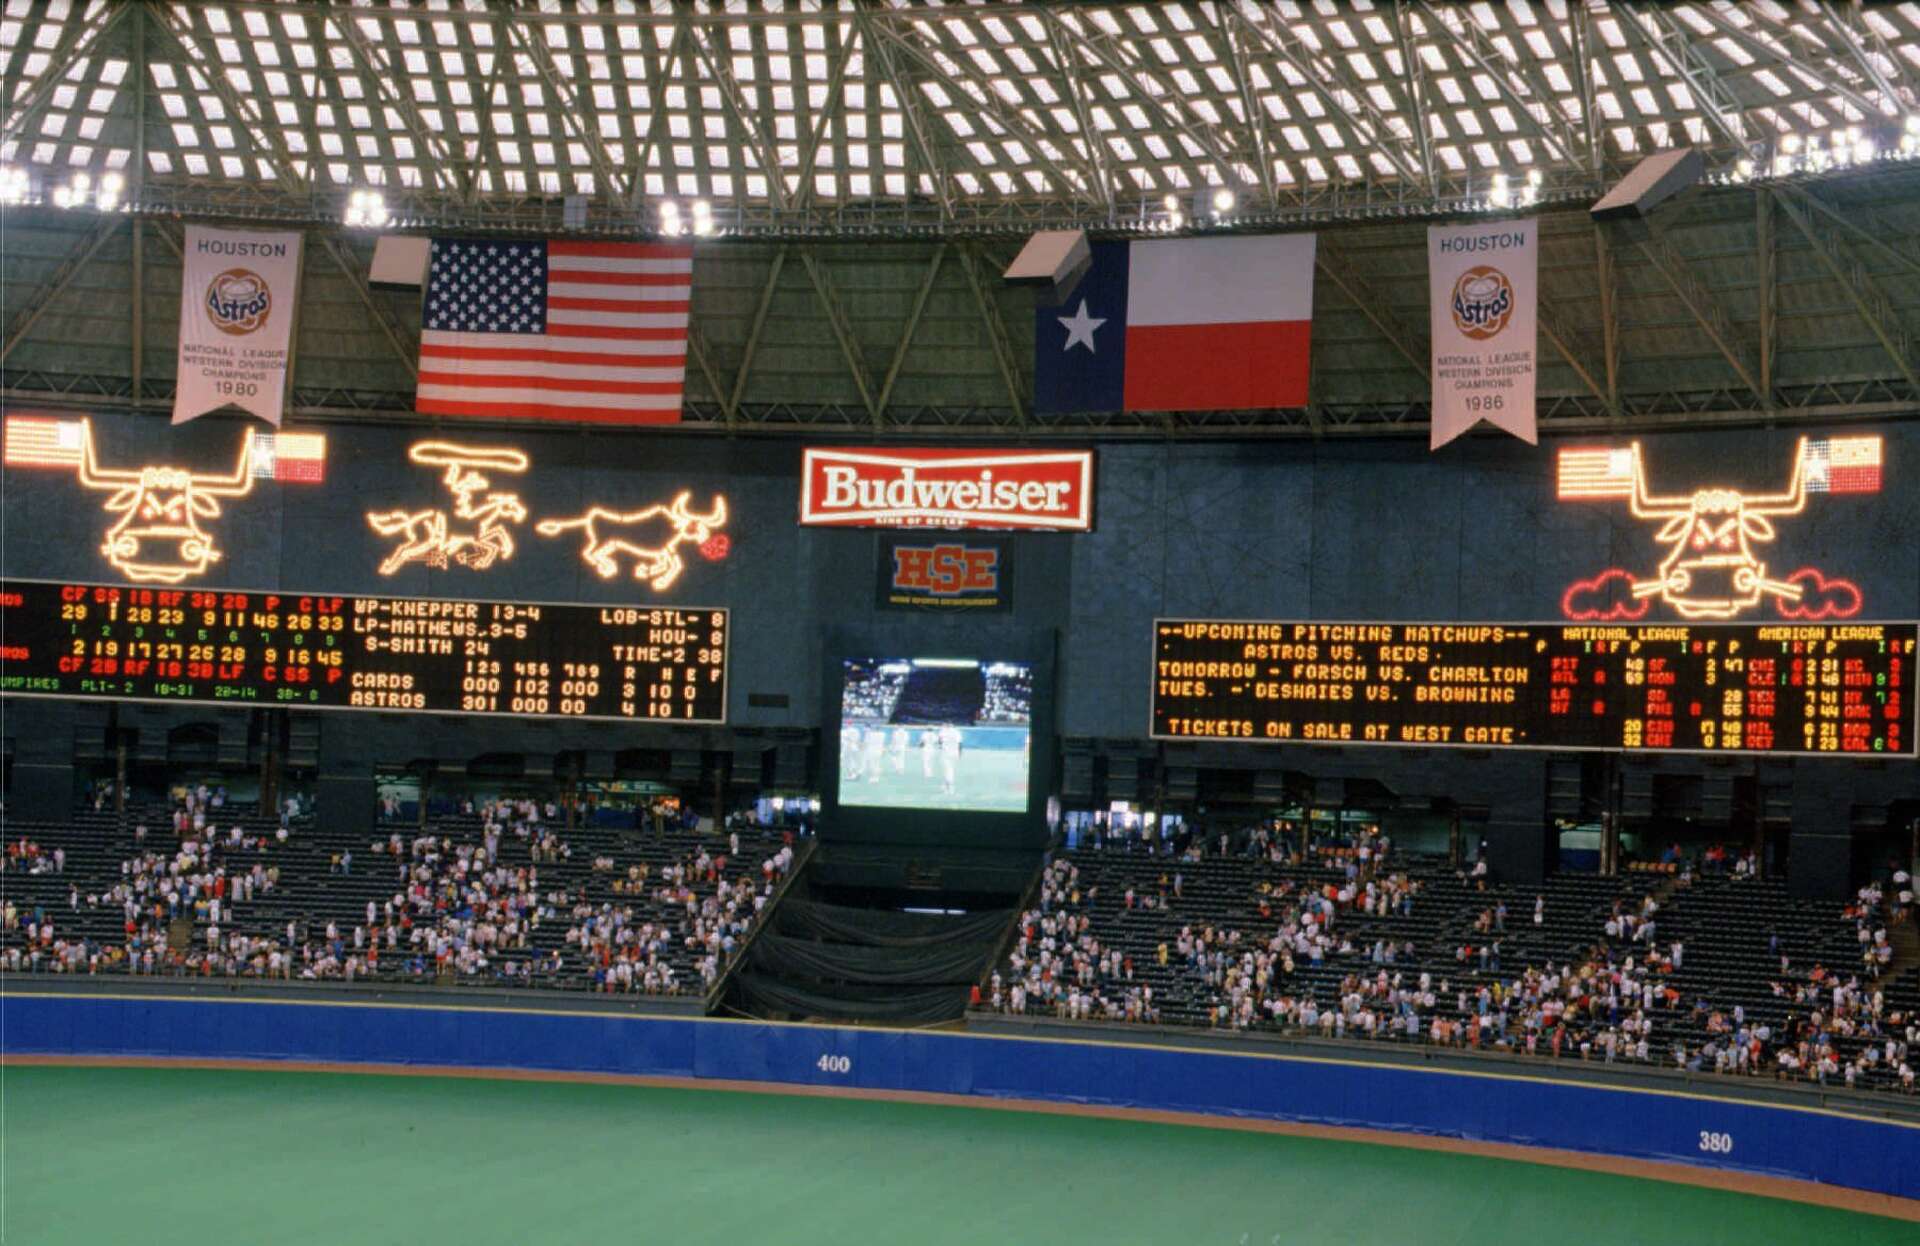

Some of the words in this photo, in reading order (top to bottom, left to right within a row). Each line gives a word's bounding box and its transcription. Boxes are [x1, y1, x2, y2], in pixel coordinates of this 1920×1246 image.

[198, 240, 286, 257] HOUSTON
[1440, 232, 1524, 252] HOUSTON
[209, 289, 267, 320] Astros
[1454, 289, 1509, 324] Astros
[184, 343, 234, 357] NATIONAL
[184, 355, 233, 368] WESTERN
[238, 359, 285, 370] DIVISION
[1437, 356, 1481, 367] NATIONAL
[202, 368, 267, 381] CHAMPIONS
[1438, 367, 1481, 379] WESTERN
[1485, 365, 1532, 377] DIVISION
[215, 382, 258, 397] 1980
[1455, 379, 1513, 390] CHAMPIONS
[1465, 395, 1504, 411] 1986
[821, 466, 1071, 511] Budweiser
[893, 545, 998, 594] HSE
[62, 587, 87, 601] CF
[159, 592, 185, 606] RF
[267, 596, 280, 610] P
[300, 597, 312, 612] C
[318, 597, 344, 613] LF
[62, 604, 87, 620] 29
[128, 607, 152, 623] 28
[158, 609, 185, 624] 23
[204, 610, 216, 626] 9
[224, 612, 245, 627] 11
[253, 613, 279, 629] 46
[288, 615, 312, 630] 26
[319, 616, 344, 631] 33
[355, 599, 479, 618] WP-KNEPPER
[493, 605, 540, 621] 13-4
[711, 612, 723, 628] 8
[102, 625, 111, 637] 2
[711, 631, 722, 645] 8
[1295, 625, 1392, 642] PITCHING
[1563, 627, 1631, 640] NATIONAL
[1638, 627, 1689, 640] LEAGUE
[1758, 626, 1825, 640] AMERICAN
[1832, 626, 1884, 640] LEAGUE
[73, 639, 85, 655] 2
[95, 641, 118, 656] 19
[129, 642, 151, 657] 17
[157, 643, 183, 659] 27
[189, 645, 214, 660] 26
[221, 647, 245, 662] 28
[265, 649, 277, 663] 9
[288, 649, 310, 664] 16
[317, 650, 343, 666] 45
[365, 636, 453, 654] S-SMITH
[464, 641, 489, 655] 24
[1244, 643, 1318, 660] ASTROS
[1380, 646, 1429, 662] REDS
[698, 649, 722, 664] 38
[1807, 658, 1816, 671] 2
[59, 656, 85, 673] CF
[124, 659, 150, 676] RF
[219, 664, 244, 679] LF
[263, 666, 277, 682] C
[327, 668, 342, 683] P
[625, 666, 636, 679] R
[662, 667, 673, 680] H
[686, 668, 696, 682] E
[710, 669, 721, 682] F
[1159, 661, 1257, 678] TOMORROW
[1294, 664, 1366, 680] FORSCH
[1429, 667, 1528, 683] CHARLTON
[352, 672, 414, 690] CARDS
[623, 683, 635, 698] 3
[650, 684, 671, 699] 10
[684, 686, 696, 700] 0
[1159, 681, 1213, 697] TUES.
[1255, 683, 1353, 700] DESHAIES
[1416, 686, 1515, 702] BROWNING
[351, 691, 426, 708] ASTROS
[561, 699, 586, 714] 00
[622, 701, 635, 716] 4
[650, 703, 671, 717] 10
[1169, 718, 1253, 736] TICKETS
[1267, 722, 1292, 737] ON
[1365, 724, 1390, 740] AT
[1402, 725, 1452, 742] WEST
[1464, 727, 1514, 743] GATE
[817, 1054, 850, 1073] 400
[1699, 1131, 1732, 1153] 380
